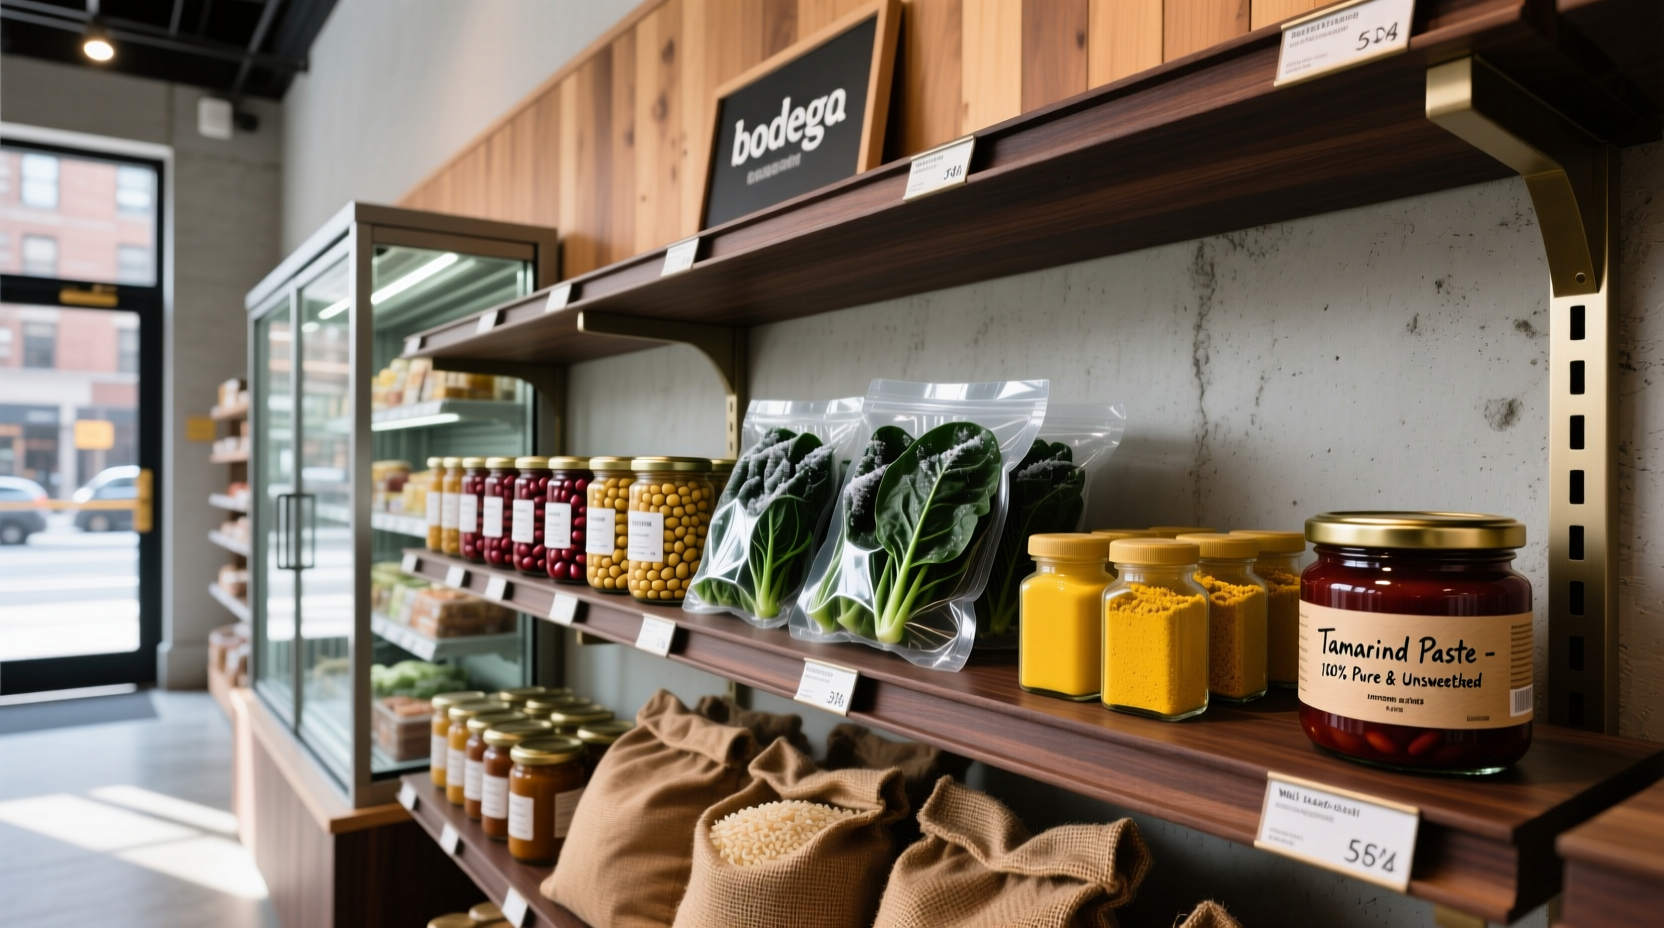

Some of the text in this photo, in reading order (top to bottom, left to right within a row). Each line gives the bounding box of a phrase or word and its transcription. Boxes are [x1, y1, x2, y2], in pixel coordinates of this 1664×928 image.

[731, 87, 847, 167] bodega
[1317, 628, 1410, 662] Tamarind
[1419, 636, 1477, 664] Paste
[1321, 663, 1347, 680] 100%
[1352, 666, 1381, 684] Pure
[1386, 670, 1396, 686] &
